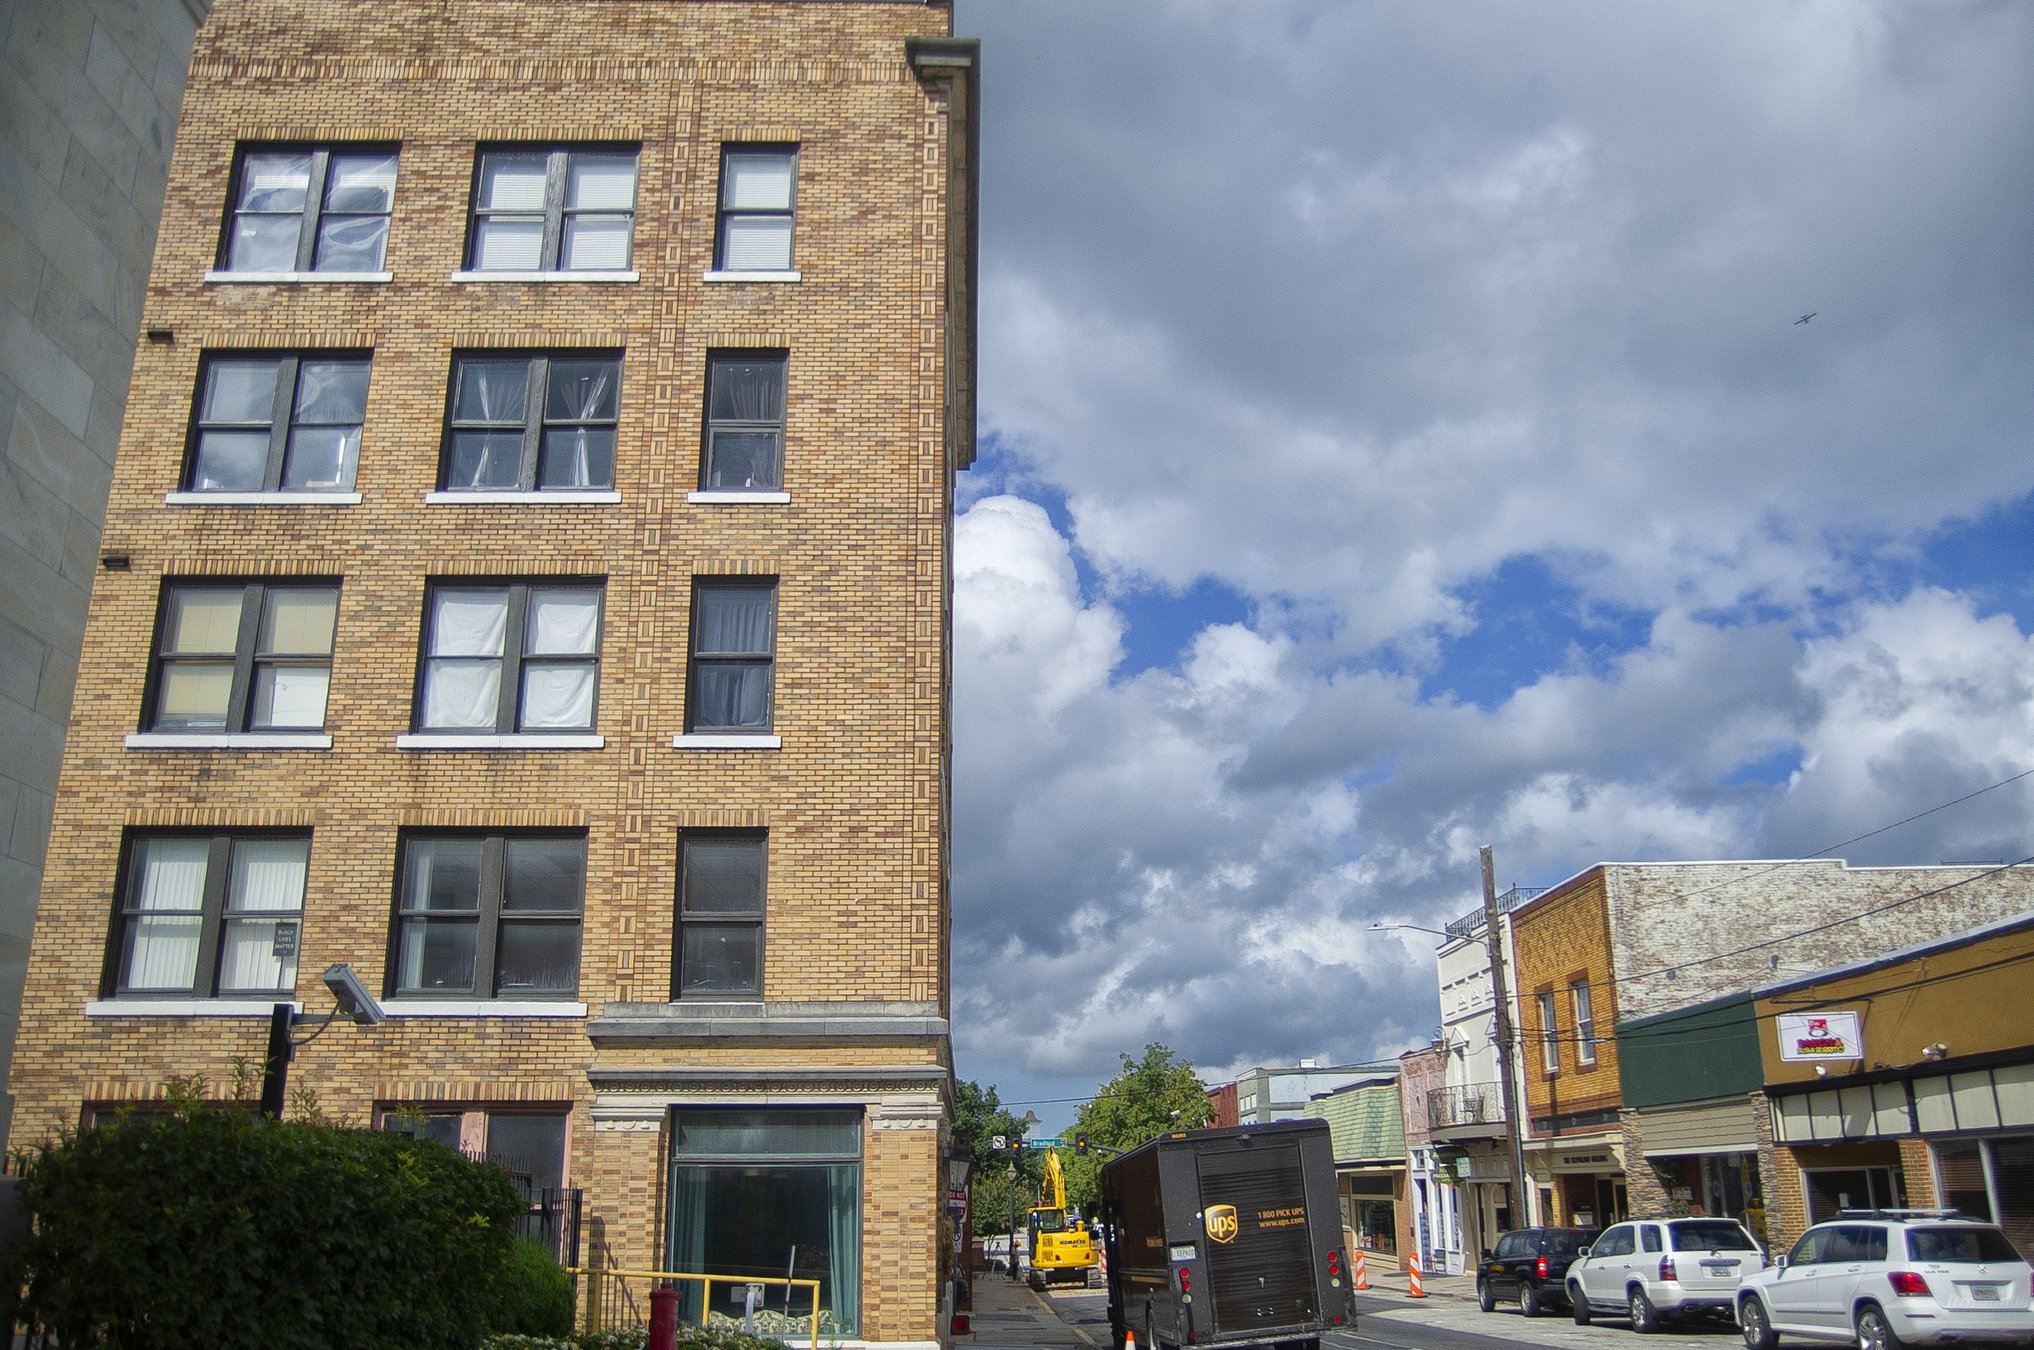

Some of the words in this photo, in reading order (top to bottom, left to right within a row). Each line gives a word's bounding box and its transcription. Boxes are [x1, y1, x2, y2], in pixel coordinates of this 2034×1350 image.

[956, 1191, 965, 1199] NOT
[1262, 1210, 1275, 1219] 800
[1276, 1209, 1290, 1218] PICK
[1291, 1207, 1304, 1215] UPS
[1208, 1215, 1235, 1237] ups
[1259, 1218, 1305, 1228] www.ups.com
